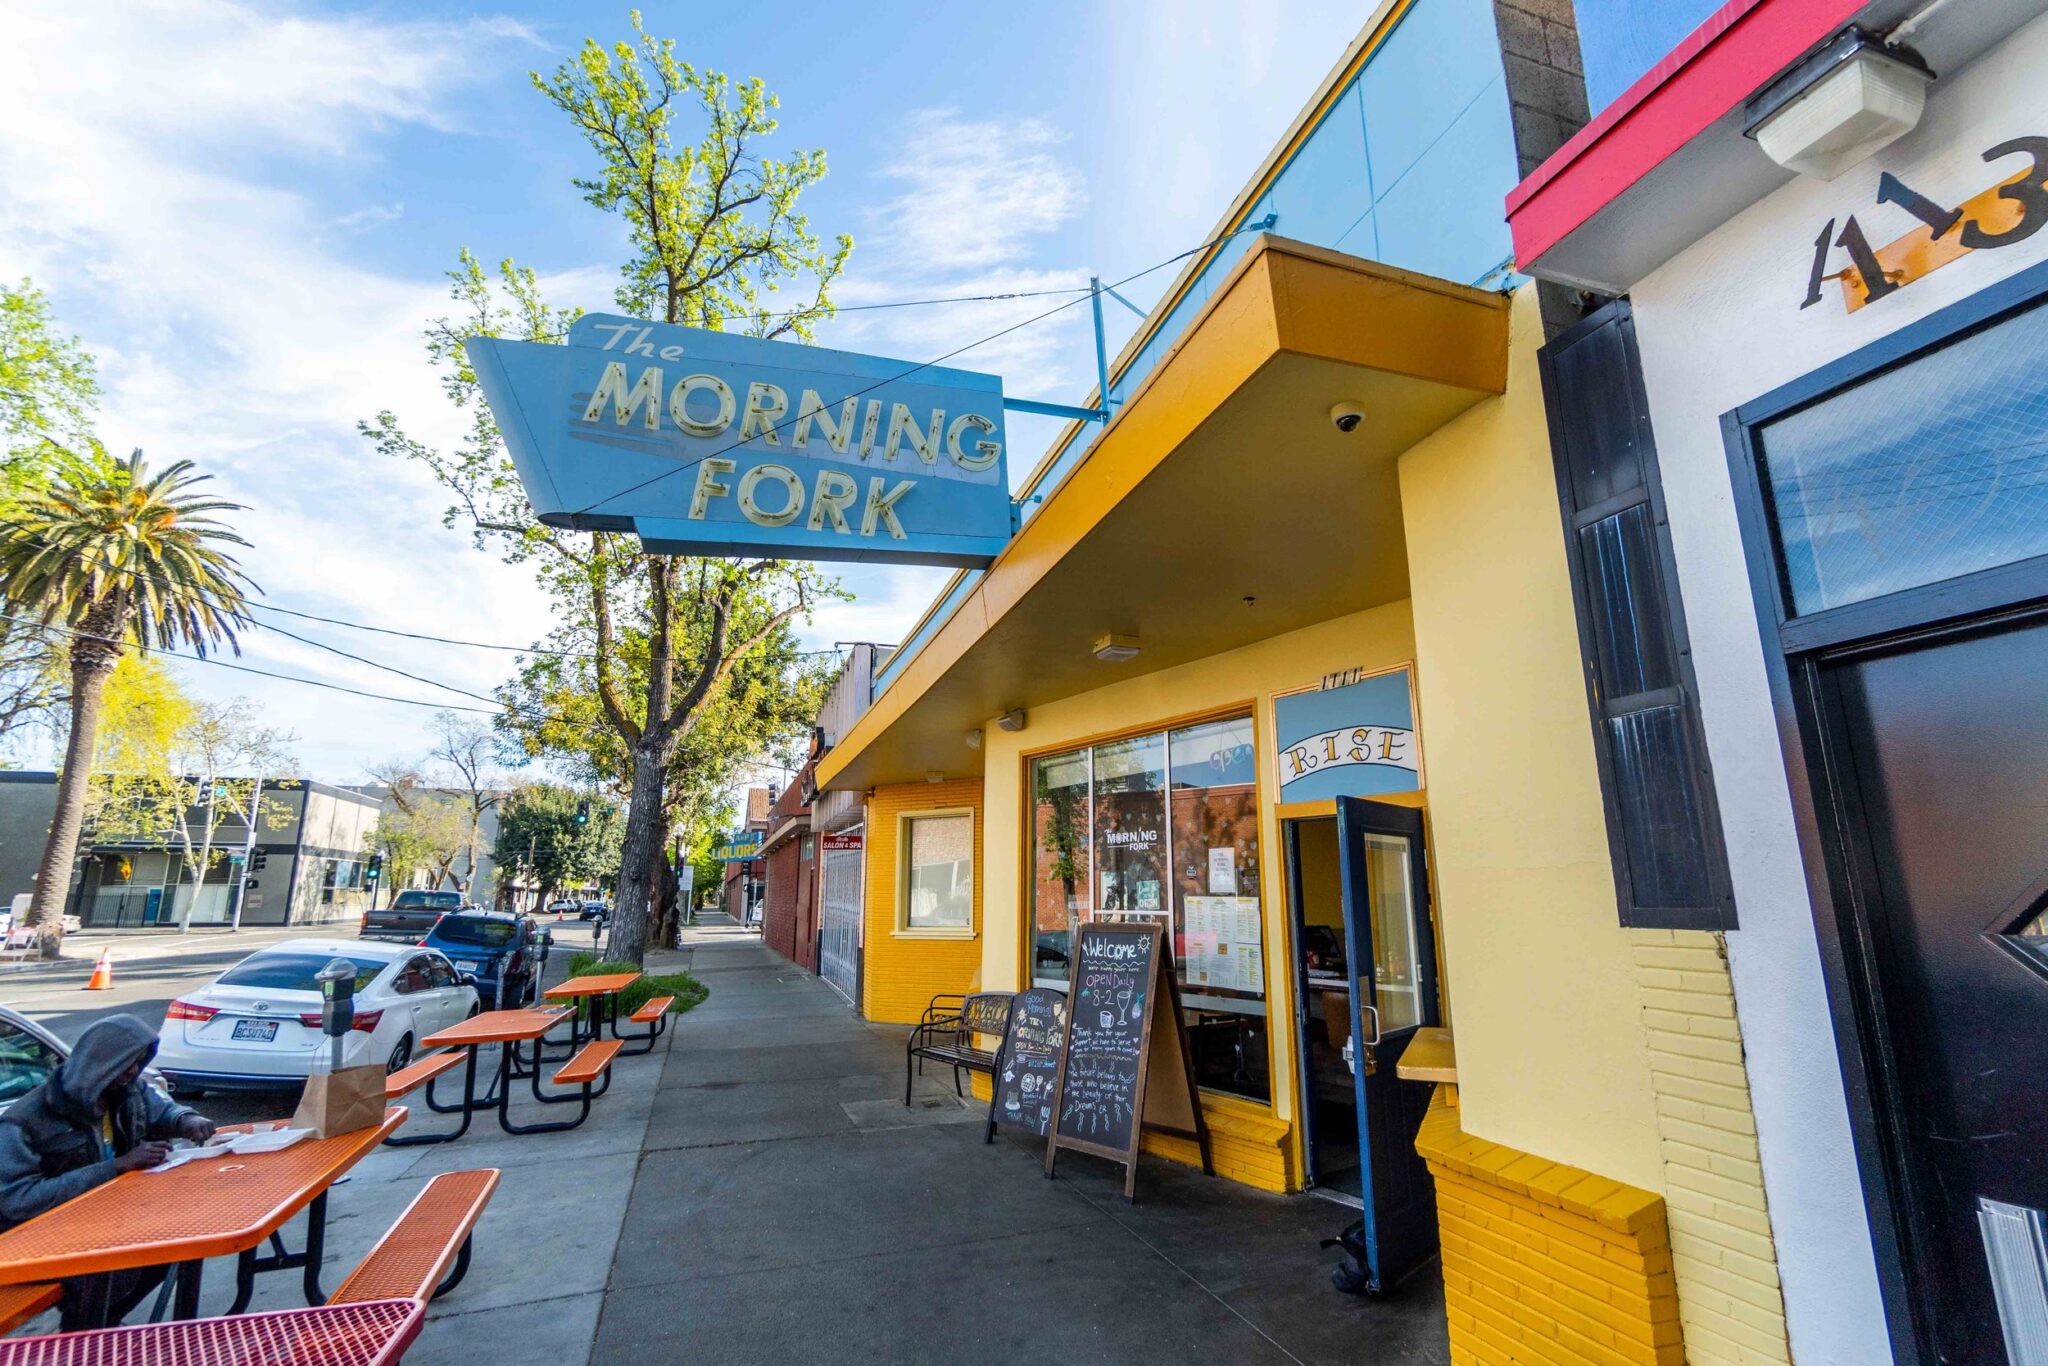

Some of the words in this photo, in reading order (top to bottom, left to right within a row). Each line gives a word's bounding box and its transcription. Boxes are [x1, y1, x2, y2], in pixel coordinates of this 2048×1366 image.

[594, 323, 684, 362] The
[582, 361, 1001, 472] MORNING
[688, 457, 918, 540] FORK
[1285, 728, 1406, 777] RISE
[824, 841, 844, 849] SALON
[850, 841, 861, 849] SPA
[1129, 842, 1149, 851] FORK
[1089, 936, 1137, 960] Welcome
[1112, 973, 1135, 989] Daily
[1026, 991, 1044, 1003] Good
[1075, 1027, 1092, 1040] Thank
[1095, 1030, 1104, 1039] you
